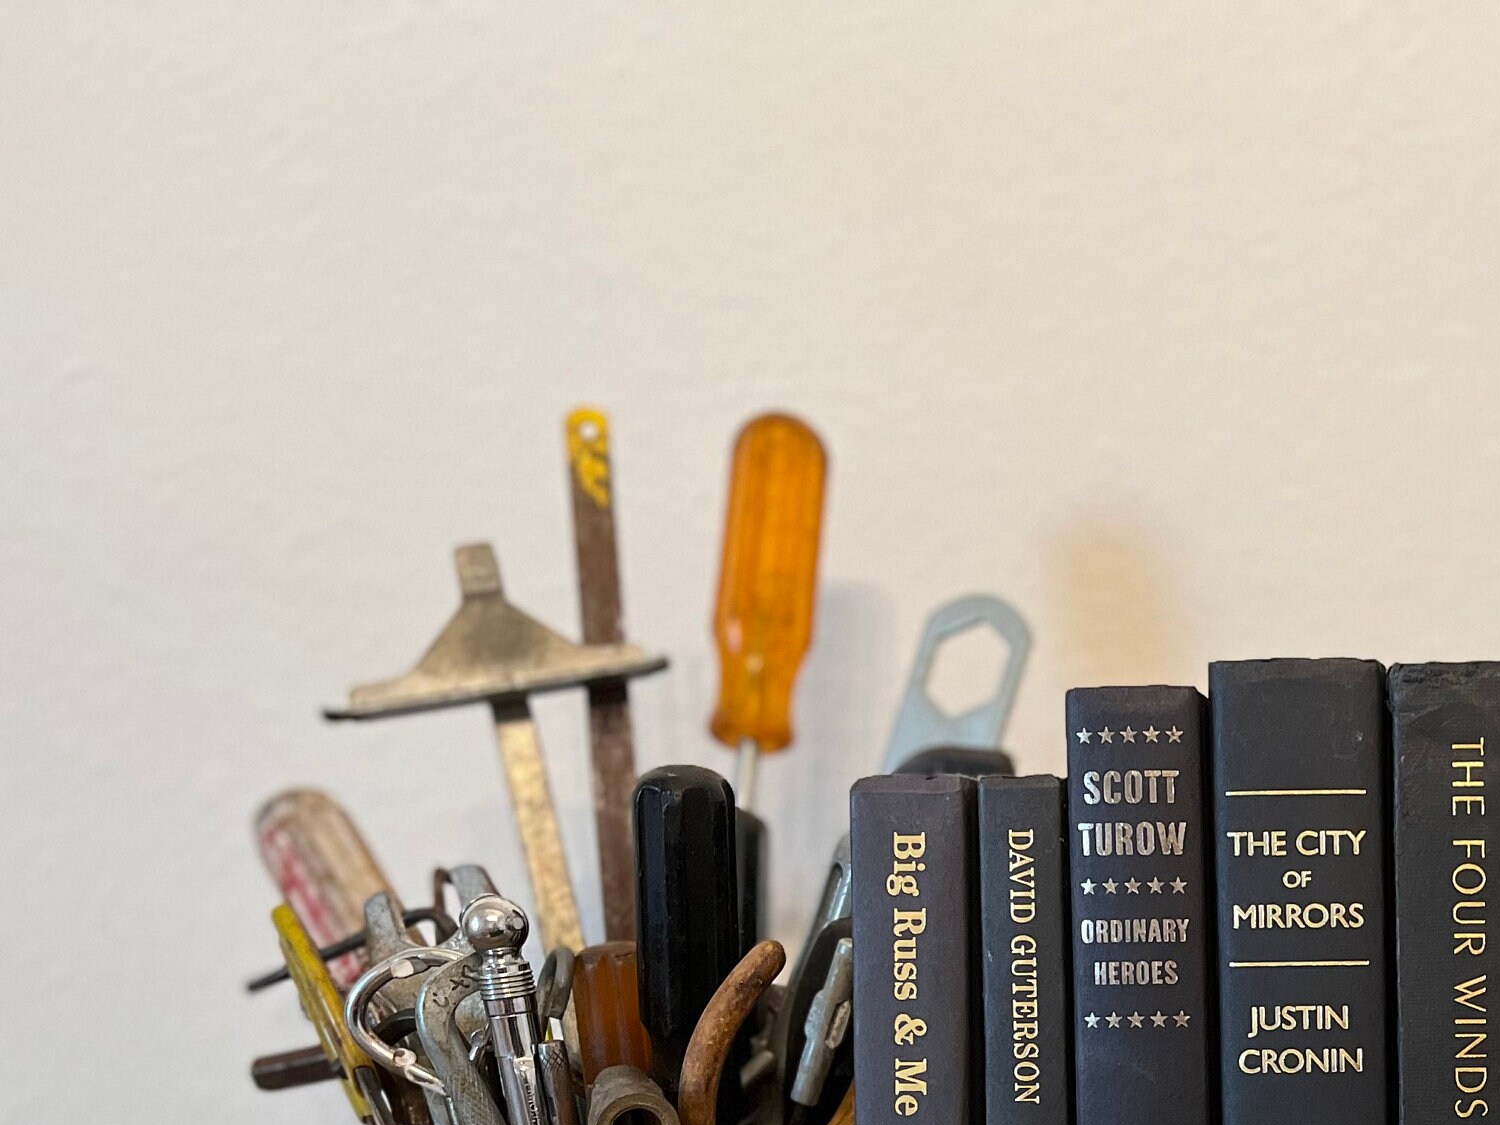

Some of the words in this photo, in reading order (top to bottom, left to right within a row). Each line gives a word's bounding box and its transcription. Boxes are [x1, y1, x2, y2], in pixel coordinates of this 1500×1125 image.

[1084, 770, 1179, 804] SCOTT
[1452, 737, 1484, 815] THE
[1078, 822, 1186, 856] TUROW
[1227, 831, 1286, 856] THE
[1296, 831, 1366, 855] CITY
[887, 832, 925, 896] Big
[1009, 829, 1035, 923] DAVID
[1283, 871, 1311, 888] OF
[1453, 840, 1486, 955] FOUR
[1081, 919, 1189, 943] ORDINARY
[1233, 903, 1364, 929] MIRRORS
[894, 908, 926, 1000] Russ
[1095, 961, 1178, 985] HEROES
[895, 1014, 927, 1045] &
[1011, 935, 1039, 1104] GUTERSON
[1248, 1006, 1348, 1038] JUSTIN
[1239, 1048, 1362, 1073] CRONIN
[1454, 975, 1488, 1117] WINDS
[895, 1058, 927, 1115] Me
